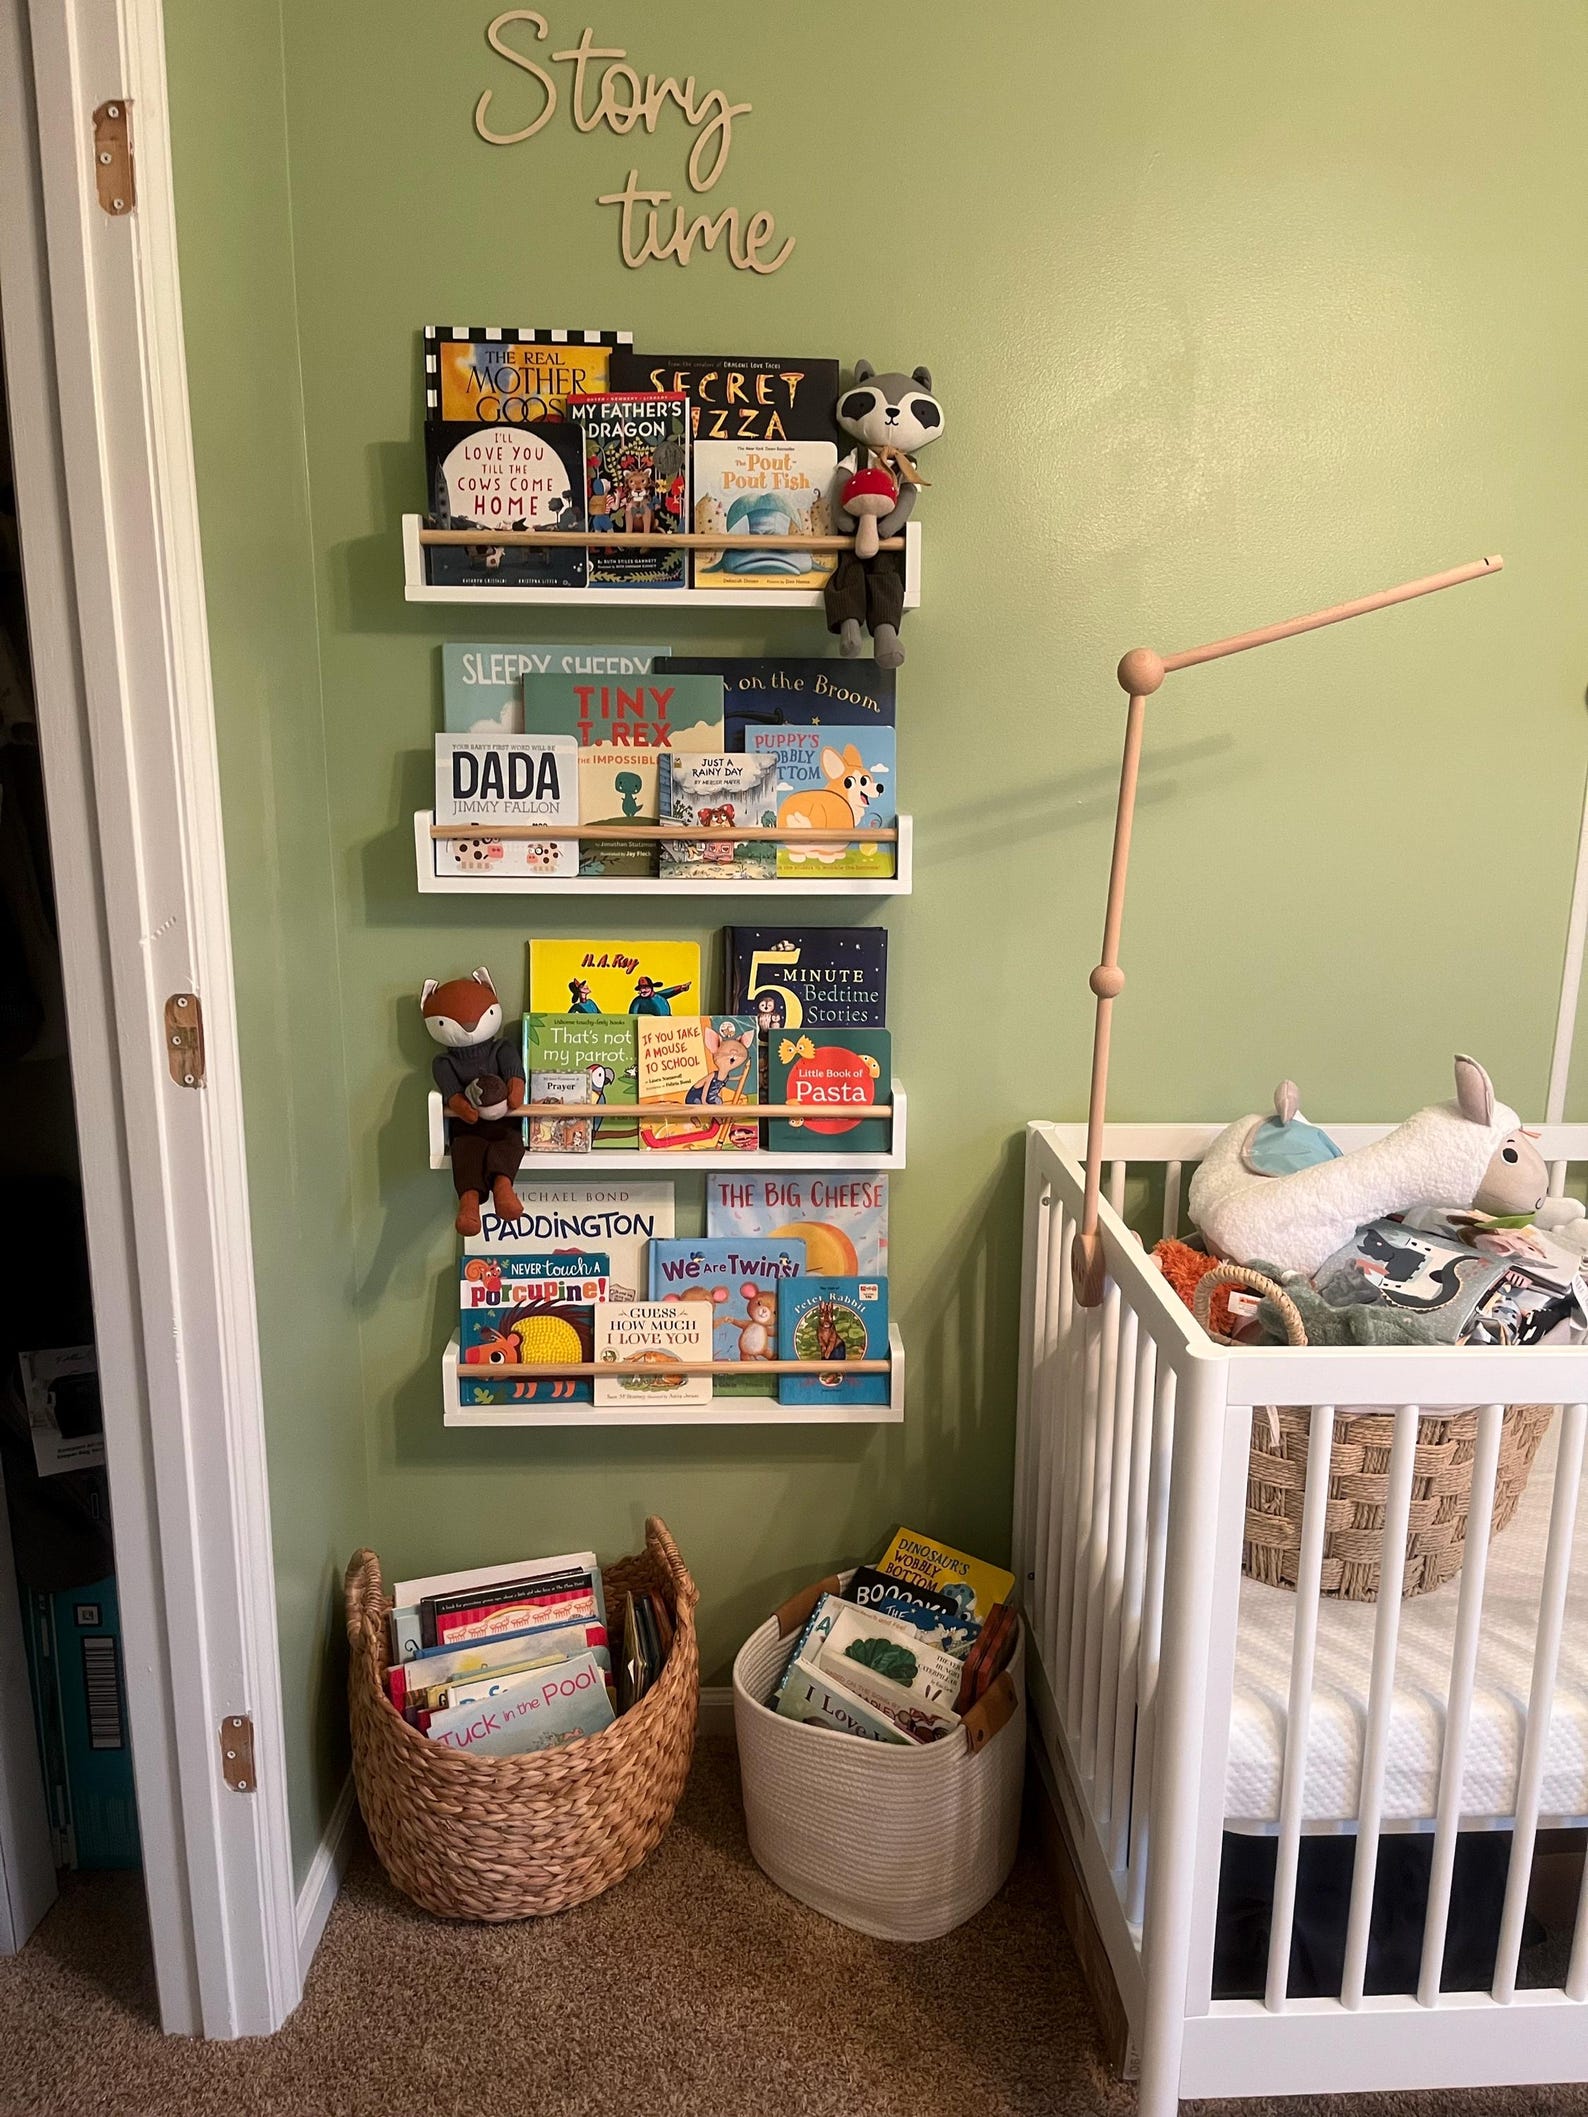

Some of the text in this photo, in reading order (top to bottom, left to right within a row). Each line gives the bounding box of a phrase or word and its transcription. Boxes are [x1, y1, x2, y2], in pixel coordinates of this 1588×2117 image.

[476, 9, 752, 192] Story
[598, 169, 795, 275] time
[485, 351, 566, 366] THE REAL
[466, 367, 587, 395] MOTHER
[650, 368, 805, 409] SECRET
[476, 397, 566, 422] GOOS
[572, 401, 682, 419] MY FATHER'S
[589, 421, 665, 438] DRAGON
[690, 407, 787, 440] IZZA
[495, 432, 513, 444] I'LL
[465, 446, 544, 461] LOVE YOU
[482, 464, 528, 475] TILL THE
[458, 478, 554, 492] COWS COME
[721, 471, 811, 490] Pout Fish
[474, 496, 539, 516] HOME
[462, 653, 552, 685] SLEEPY
[573, 685, 676, 720] TINY
[739, 675, 766, 690] on
[772, 672, 805, 691] the
[812, 674, 881, 713] Broom
[577, 722, 672, 748] T. REX
[755, 734, 820, 748] PUPPY'S
[702, 758, 734, 767] JUST A
[756, 749, 816, 764] OBBLY
[452, 751, 560, 800] DADA
[692, 768, 743, 778] RAINY DAY
[777, 766, 822, 781] TTOM
[453, 800, 560, 816] JIMMY FALLON
[581, 953, 639, 975] H. A. Rey
[747, 948, 803, 1028] 5
[804, 983, 880, 1004] Bedtime
[807, 1006, 868, 1025] Stories
[550, 1026, 632, 1045] That's not
[642, 1026, 701, 1047] IF YOU TAKE
[544, 1050, 570, 1066] my
[644, 1042, 688, 1059] A MOUSE
[645, 1056, 701, 1075] TO SCHOOL
[798, 1068, 864, 1078] Little Book of
[547, 1082, 576, 1092] Prayer
[795, 1080, 868, 1103] Pasta
[516, 1192, 630, 1202] ICHAEL BOND
[718, 1180, 884, 1209] THE BIG CHEESE
[482, 1212, 655, 1242] PADDINGTON
[511, 1257, 601, 1278] NEVER touch A
[662, 1254, 800, 1282] We Are Twins!
[471, 1278, 606, 1308] porcupine!
[794, 1295, 823, 1314] Peter
[829, 1292, 867, 1313] Rabbit
[630, 1308, 677, 1319] GUESS
[610, 1320, 697, 1332] HOW MUCH
[607, 1332, 700, 1345] I LOVE YOU
[894, 1550, 943, 1578] WOBBLY
[898, 1538, 970, 1576] DINOSAUR'S
[884, 1563, 940, 1592] BOTTOM
[886, 1604, 910, 1620] THE
[918, 1663, 958, 1686] CATERPILLAR
[502, 1710, 516, 1722] in
[517, 1697, 540, 1718] the
[541, 1664, 597, 1706] Pool
[804, 1684, 867, 1737] I Love
